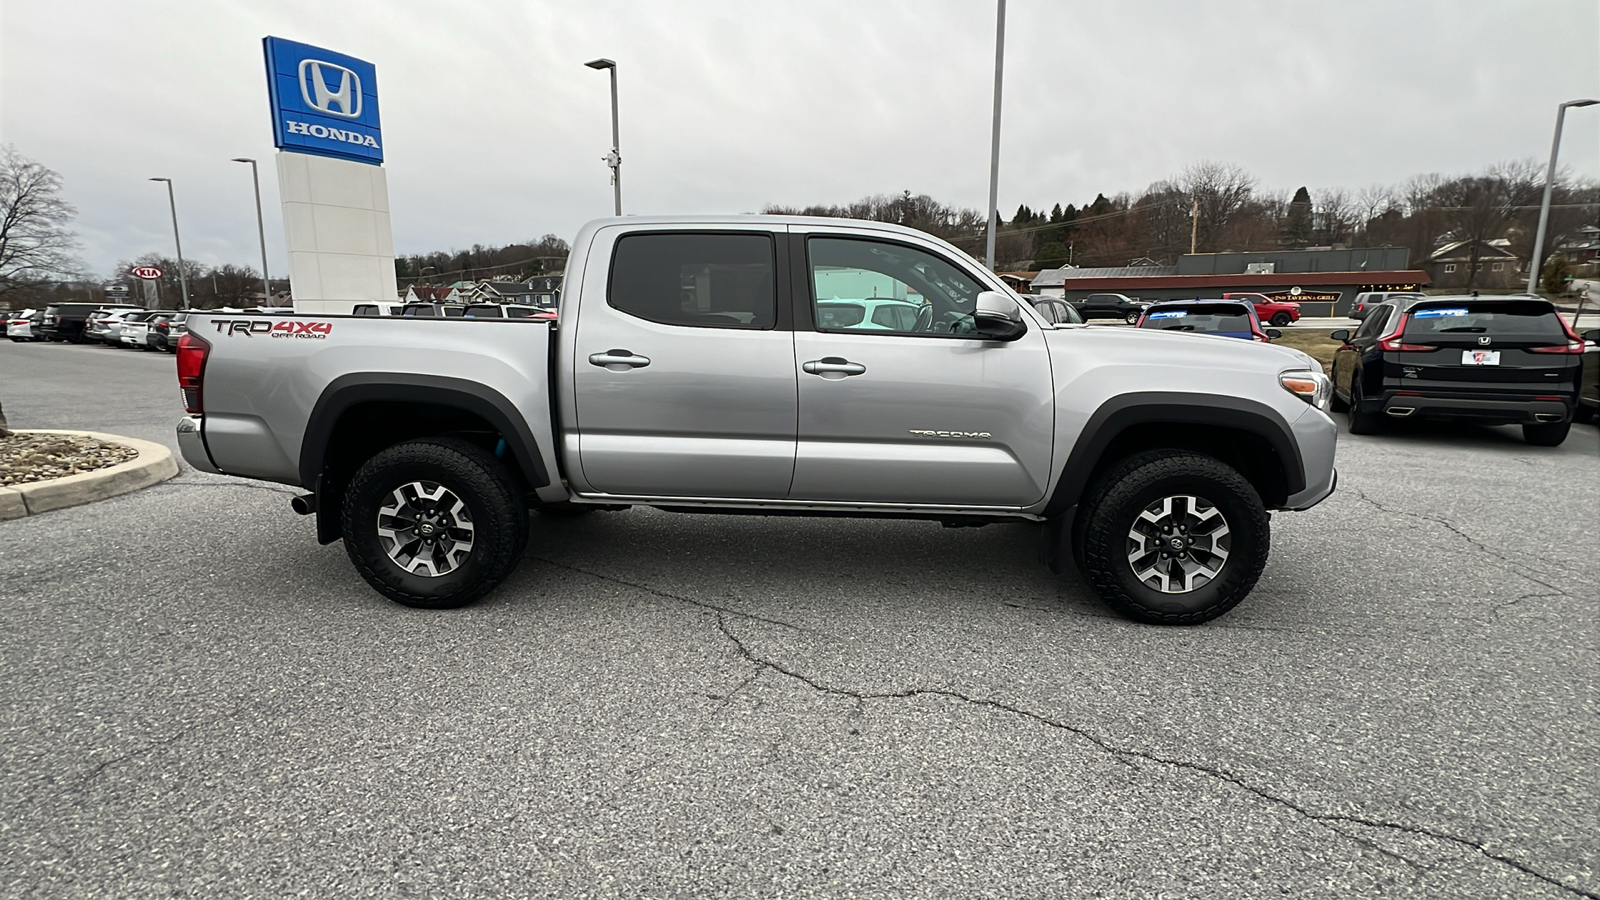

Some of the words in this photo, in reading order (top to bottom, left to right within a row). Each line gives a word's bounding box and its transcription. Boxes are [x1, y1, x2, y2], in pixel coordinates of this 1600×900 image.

[286, 120, 380, 149] HONDA
[139, 269, 159, 277] KIA
[909, 429, 992, 439] TACOMA
